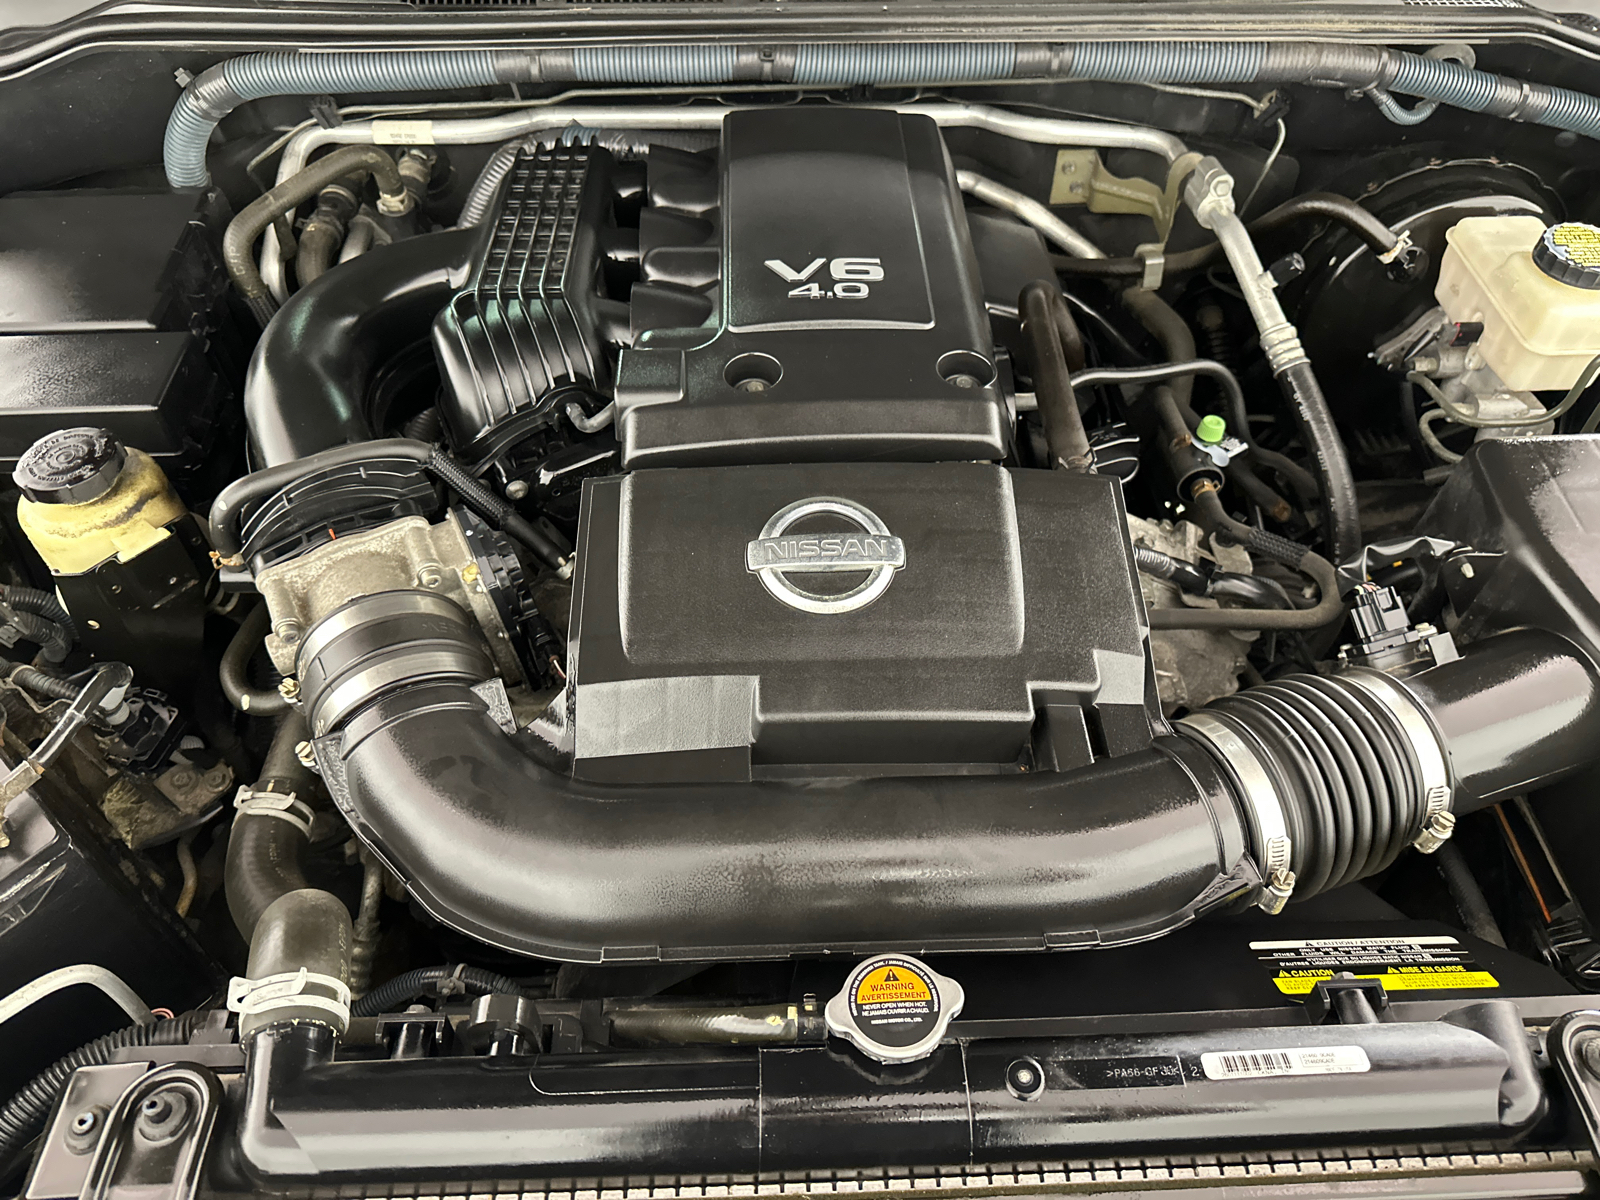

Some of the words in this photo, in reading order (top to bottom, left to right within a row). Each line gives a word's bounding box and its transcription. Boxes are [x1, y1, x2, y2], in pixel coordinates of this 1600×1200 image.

[763, 257, 885, 283] V6
[787, 282, 870, 300] 4.0
[764, 539, 889, 561] NISSAN
[1290, 969, 1335, 977] CAUTION
[870, 982, 915, 992] WARNING
[861, 991, 927, 1002] AVERTISSEMENT
